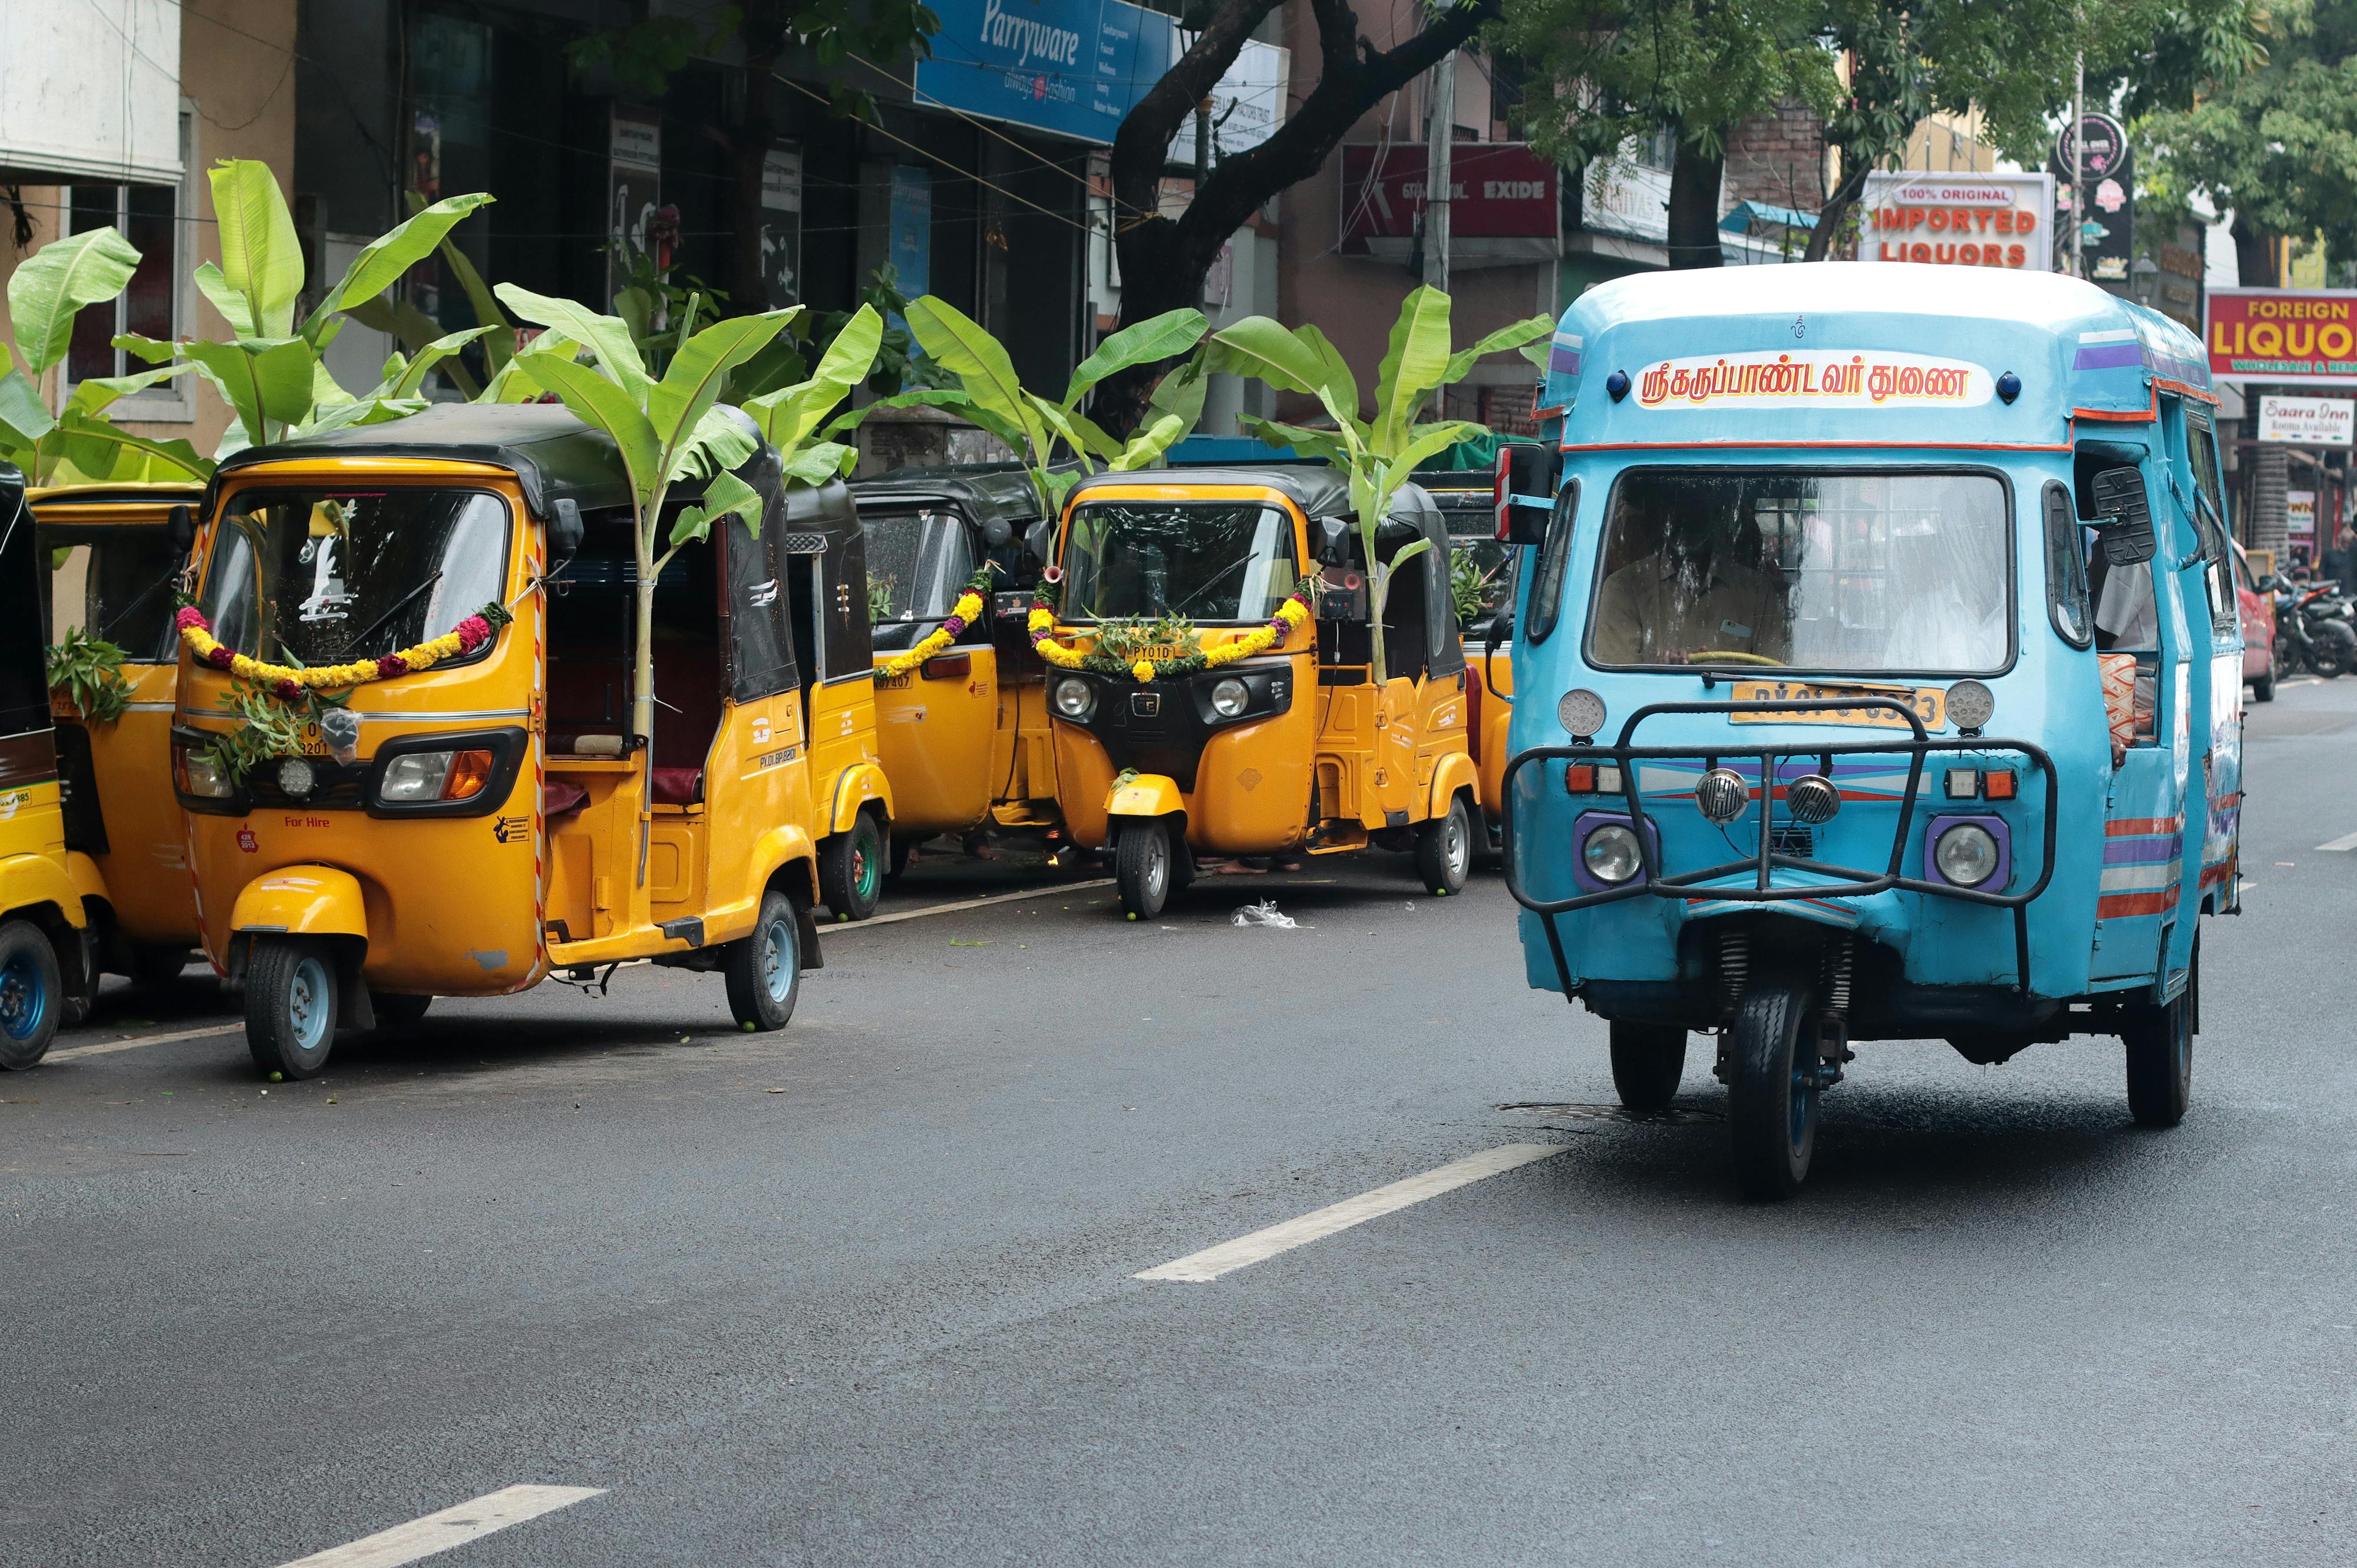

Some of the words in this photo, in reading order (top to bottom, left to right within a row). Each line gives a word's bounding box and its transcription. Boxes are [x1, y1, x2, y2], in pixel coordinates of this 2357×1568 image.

[981, 0, 1079, 66] Parryware
[1484, 180, 1545, 199] EXIDE
[1901, 189, 1937, 200] 100%
[1942, 189, 2009, 202] ORIGINAL
[1872, 207, 2036, 233] IMPORTED
[1880, 242, 2026, 267] LIQUORS
[2248, 301, 2349, 319] FOREIGN
[2213, 321, 2357, 359] LIQUO
[2231, 359, 2313, 372] WHOLESALE
[2266, 400, 2315, 419] Saara
[2319, 402, 2349, 420] Inn
[2272, 421, 2300, 432] Rooms
[2303, 422, 2342, 433] Available
[285, 817, 302, 827] For
[306, 817, 329, 828] Hire
